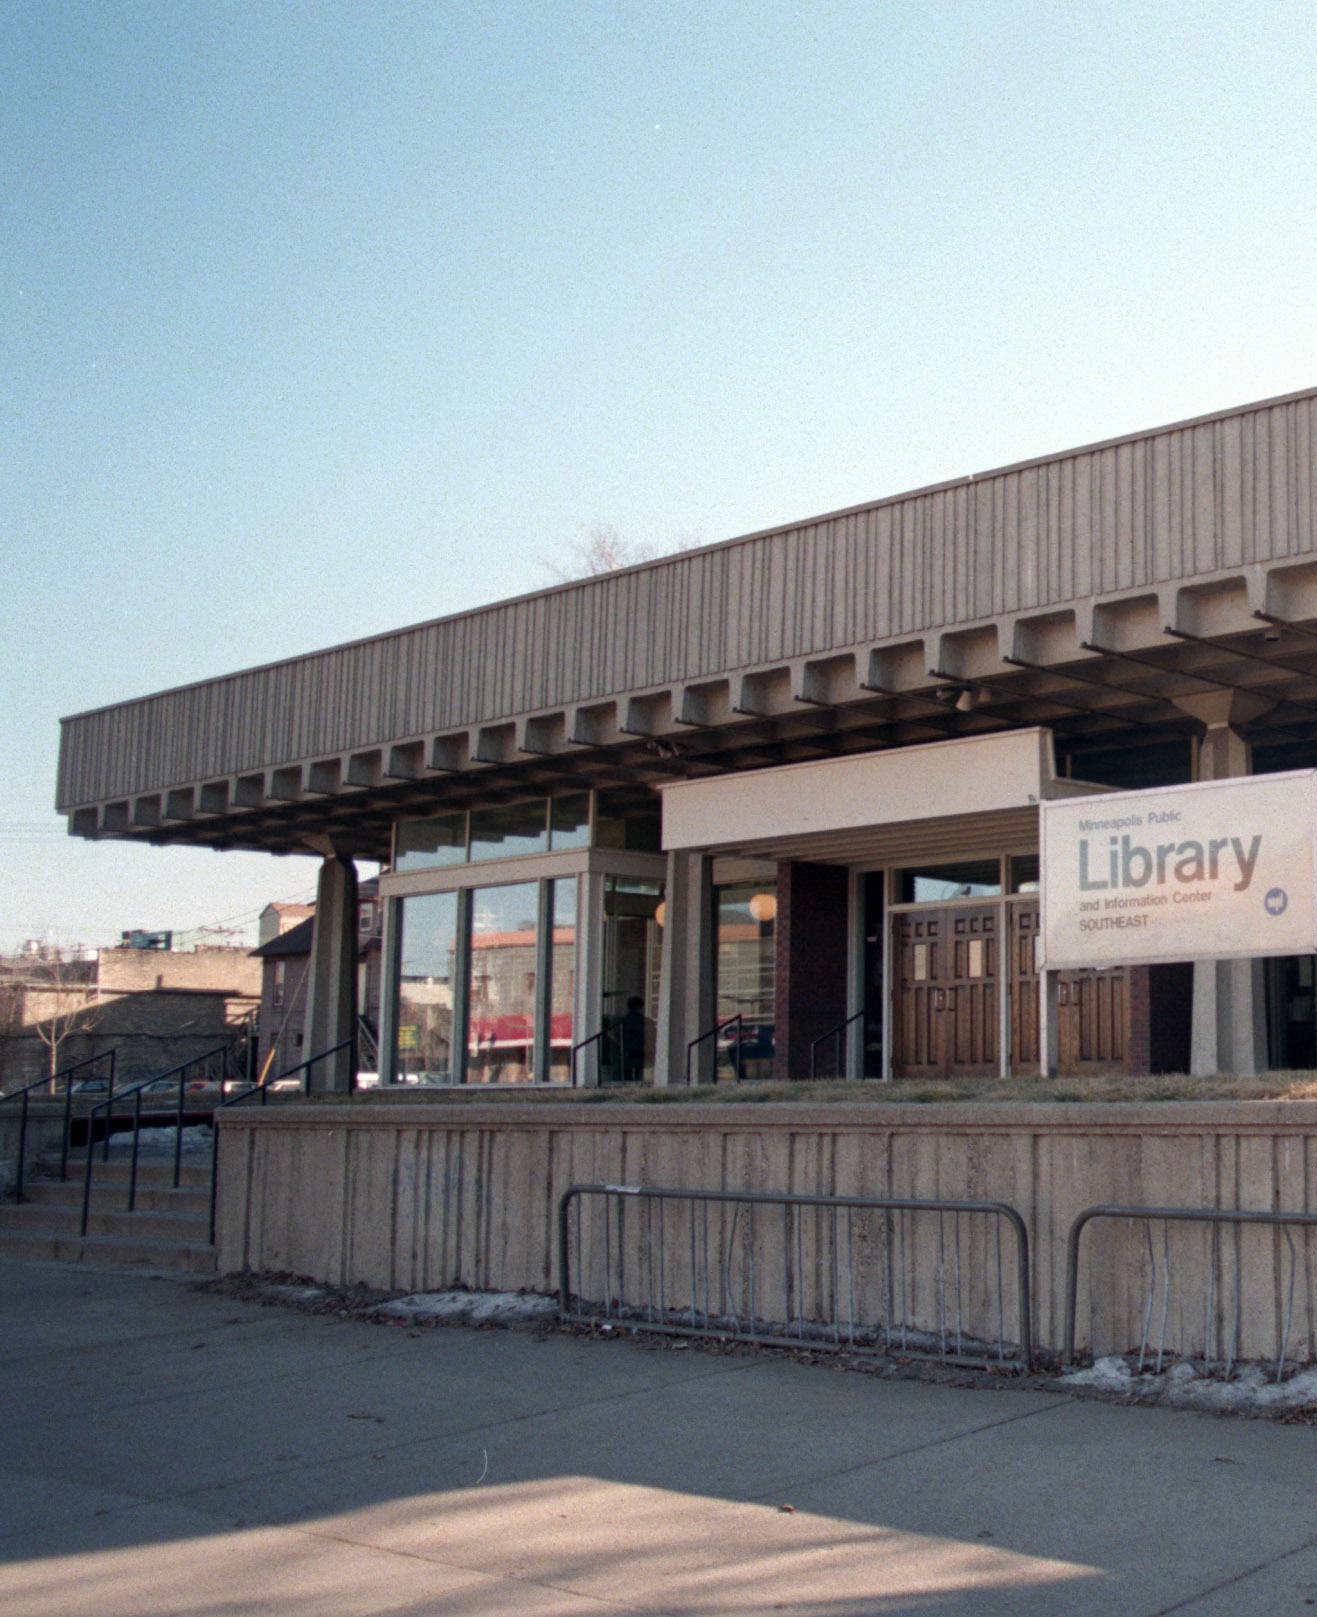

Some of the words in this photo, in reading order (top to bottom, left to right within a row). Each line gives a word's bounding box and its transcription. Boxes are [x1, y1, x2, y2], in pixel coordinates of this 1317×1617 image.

[1079, 814, 1143, 832] Minneapolis
[1148, 810, 1182, 824] Public
[1079, 834, 1263, 892] Library
[1079, 899, 1100, 912] and
[1105, 894, 1168, 909] Information
[1172, 890, 1212, 904] Center
[1080, 915, 1148, 932] SOUTHEAST
